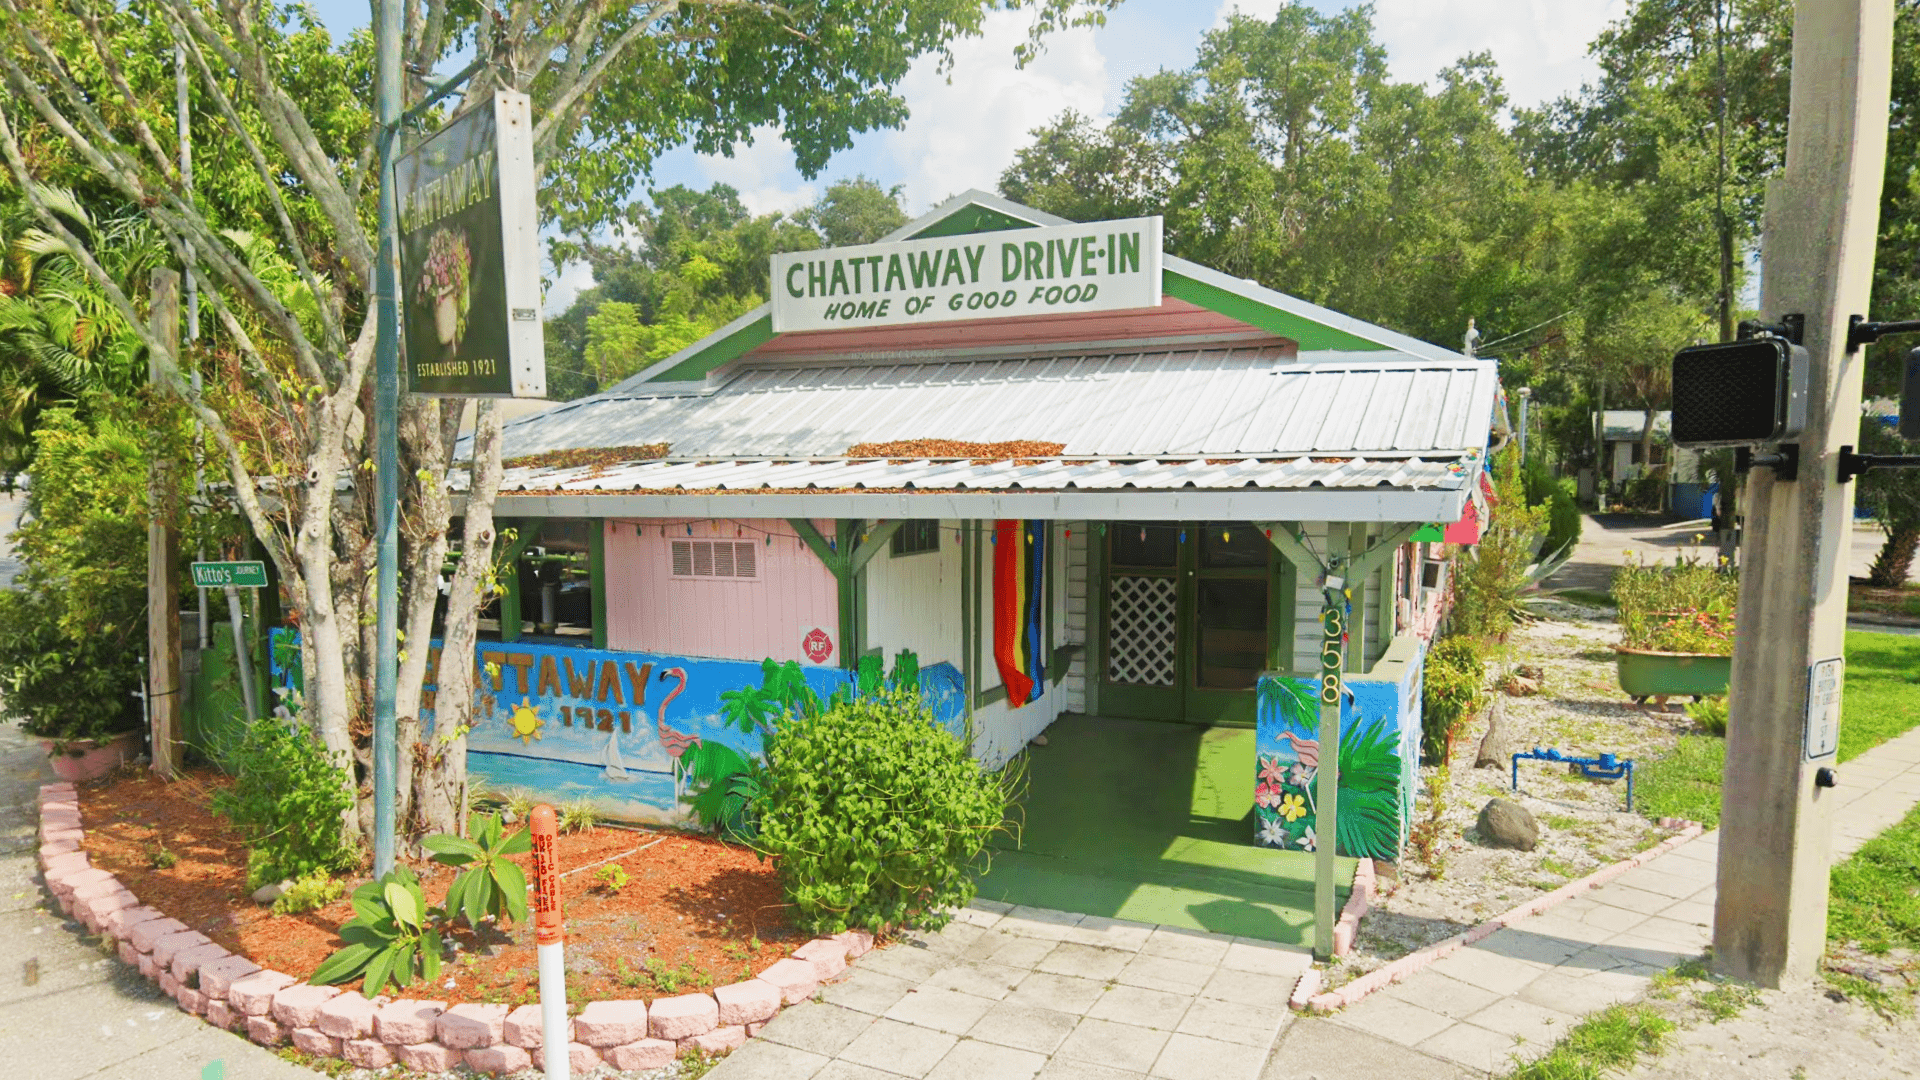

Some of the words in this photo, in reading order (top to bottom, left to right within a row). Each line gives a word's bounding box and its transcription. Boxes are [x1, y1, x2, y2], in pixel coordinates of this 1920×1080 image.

[401, 151, 492, 235] CHATTAWAY
[786, 244, 986, 298] CHATTAWAY
[823, 299, 890, 321] HOME
[904, 295, 936, 316] OF
[949, 289, 1018, 311] GOOD
[1027, 283, 1099, 306] FOOD
[417, 361, 469, 377] ESTABLISHED
[473, 359, 496, 376] 1921
[195, 566, 232, 583] Kitto's
[811, 641, 825, 652] RF
[424, 648, 652, 706] TTAWAY
[560, 705, 632, 734] 1921
[545, 834, 555, 871] OPTIC
[548, 875, 556, 911] CABLE
